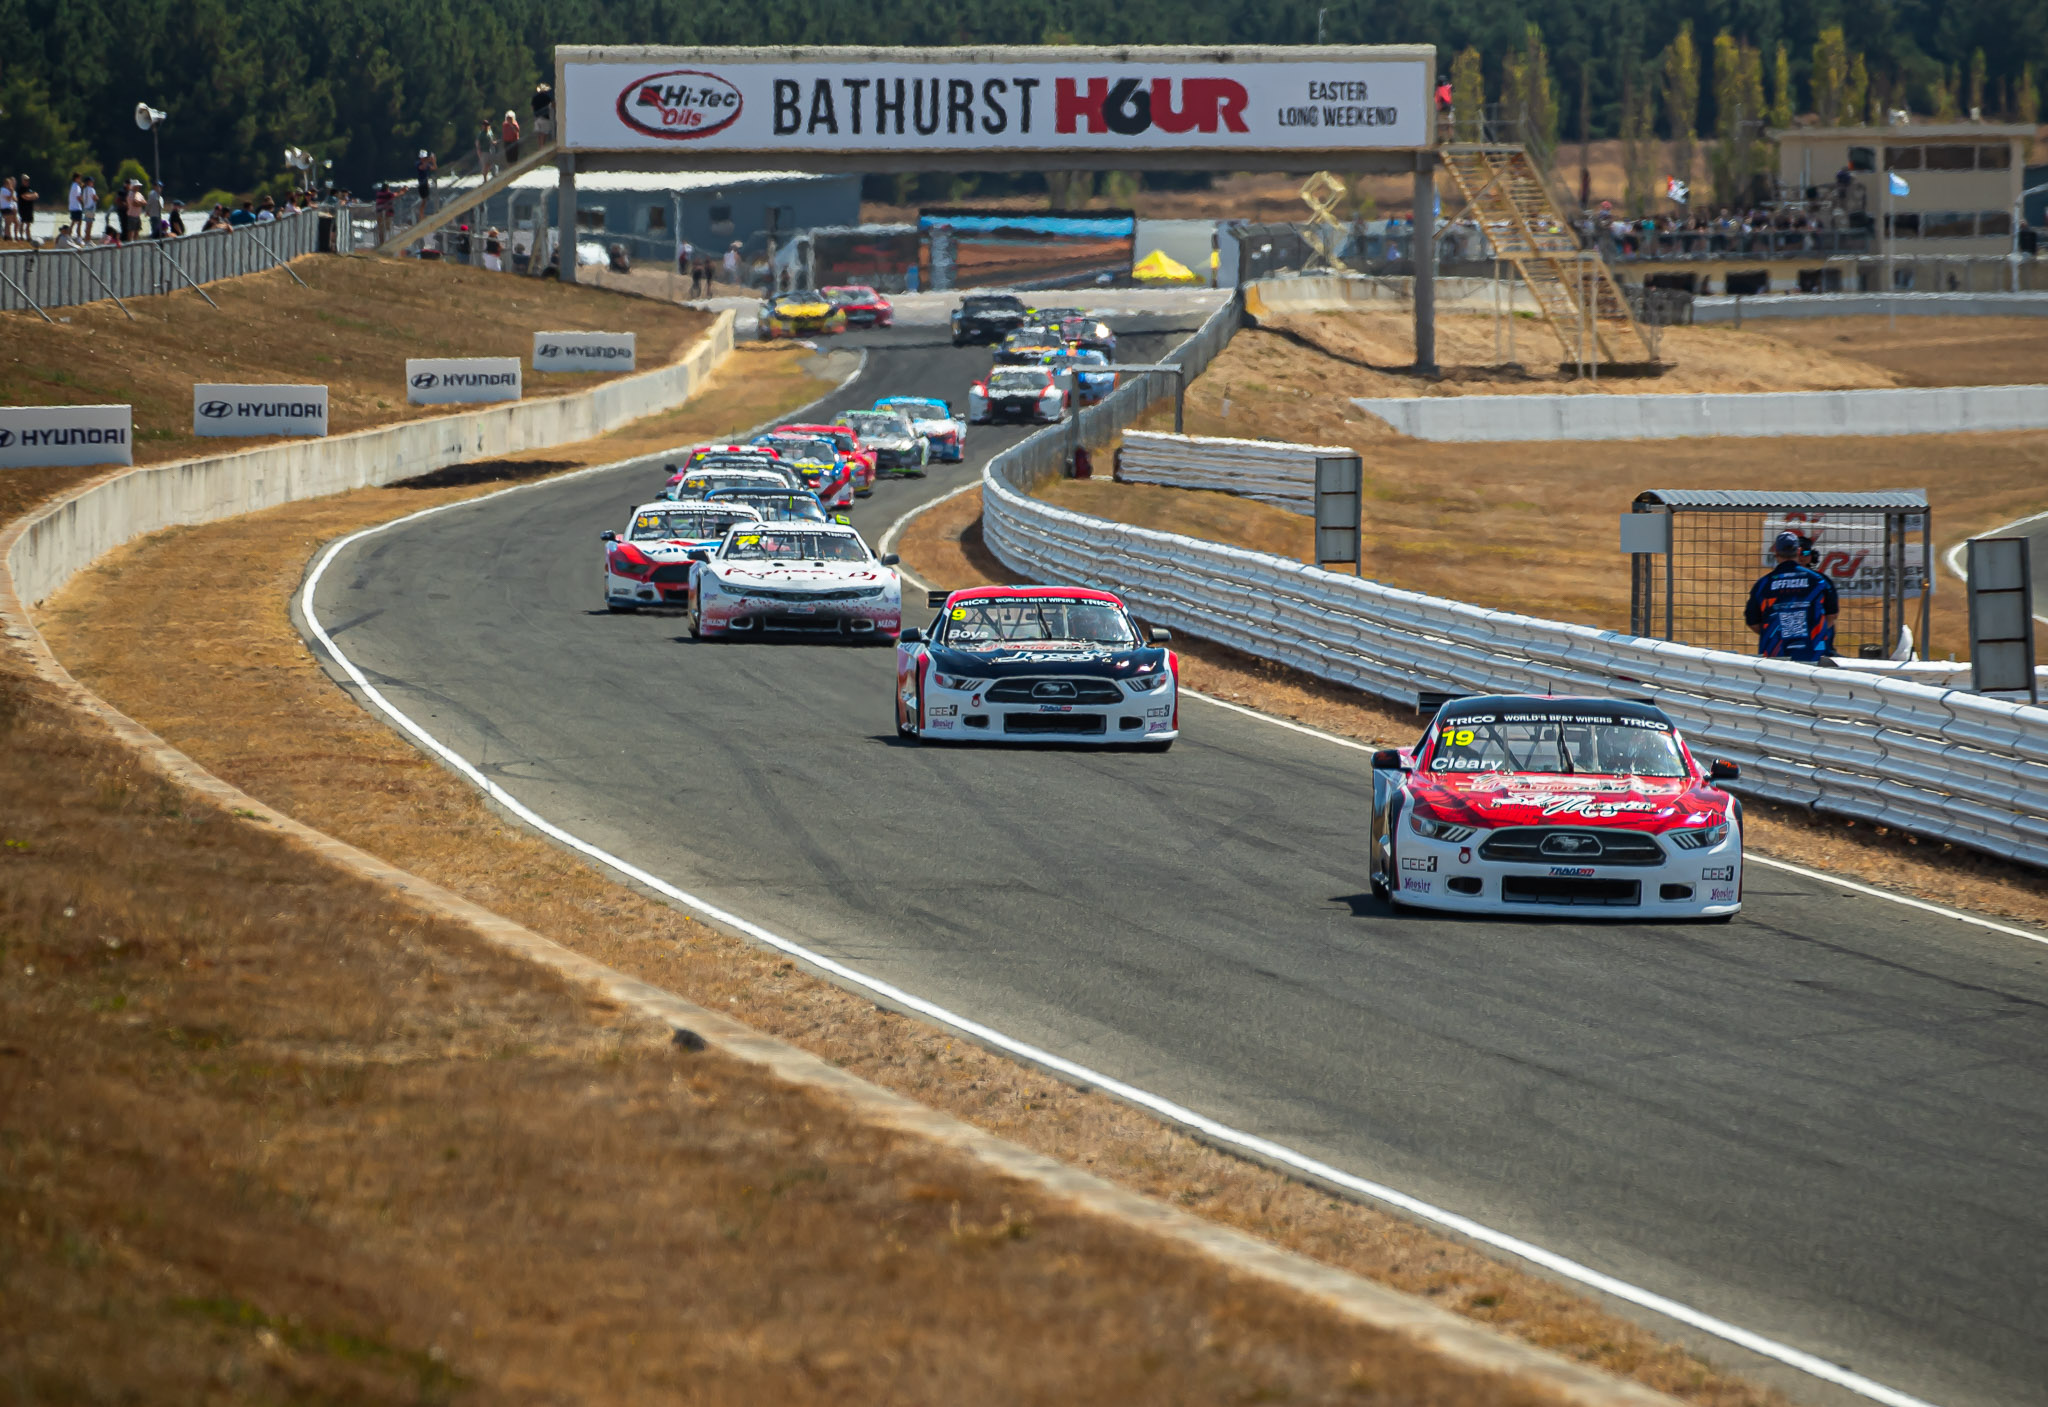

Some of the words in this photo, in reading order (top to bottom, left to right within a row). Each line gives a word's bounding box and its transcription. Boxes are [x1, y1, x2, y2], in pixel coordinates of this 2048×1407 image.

[664, 85, 738, 107] Hi-Tec
[1309, 81, 1367, 101] EASTER
[773, 78, 1040, 136] BATHURST
[662, 108, 703, 126] Oils
[1278, 106, 1319, 127] LONG
[1323, 106, 1398, 127] WEEKEND
[565, 346, 633, 359] HYUNDAI
[443, 372, 517, 387] HYUNDAI
[237, 403, 323, 418] HYUNDAI
[21, 428, 126, 446] HYUNDAI
[1771, 578, 1809, 590] OFFICIAL
[954, 598, 990, 607] TRICO
[1081, 598, 1118, 607] TRICO
[951, 609, 967, 621] 9
[948, 629, 989, 640] Boys
[1446, 715, 1496, 726] TRICO
[1503, 714, 1547, 722] WORLD'S
[1549, 714, 1574, 722] BEST
[1575, 715, 1613, 724] WIPERS
[1620, 717, 1669, 730] TRICO
[1442, 730, 1475, 746] 19
[1431, 757, 1503, 771] Cleary
